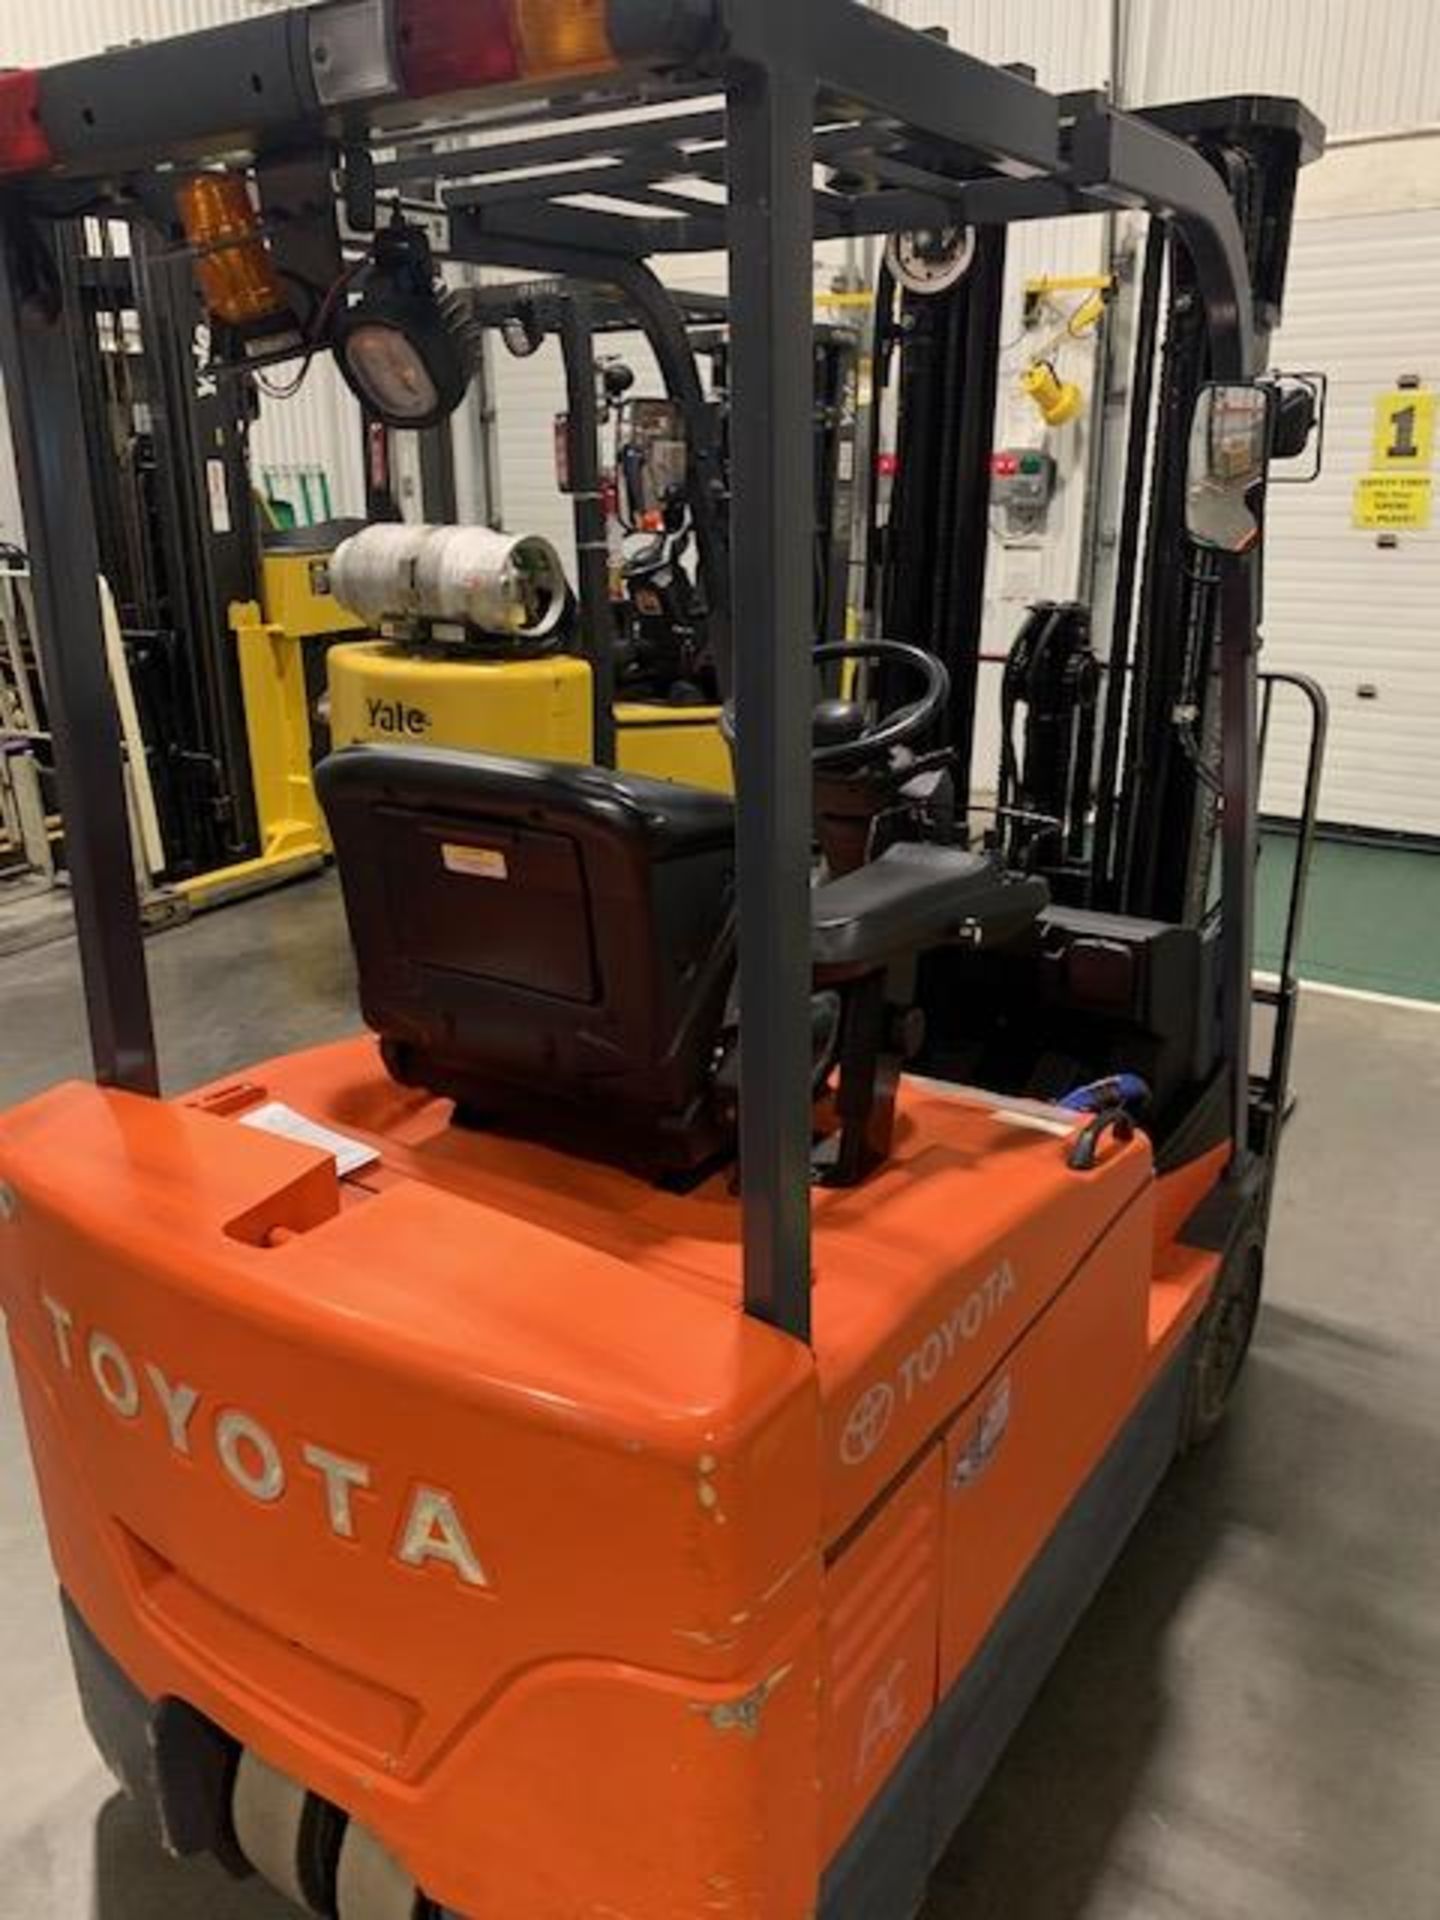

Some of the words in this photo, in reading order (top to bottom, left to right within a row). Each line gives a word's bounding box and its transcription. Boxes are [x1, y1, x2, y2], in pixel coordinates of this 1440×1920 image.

[1387, 405, 1417, 457] 1
[365, 698, 427, 734] Yale
[898, 1258, 1015, 1402] TOYOTA
[43, 1294, 489, 1587] TOYOTA
